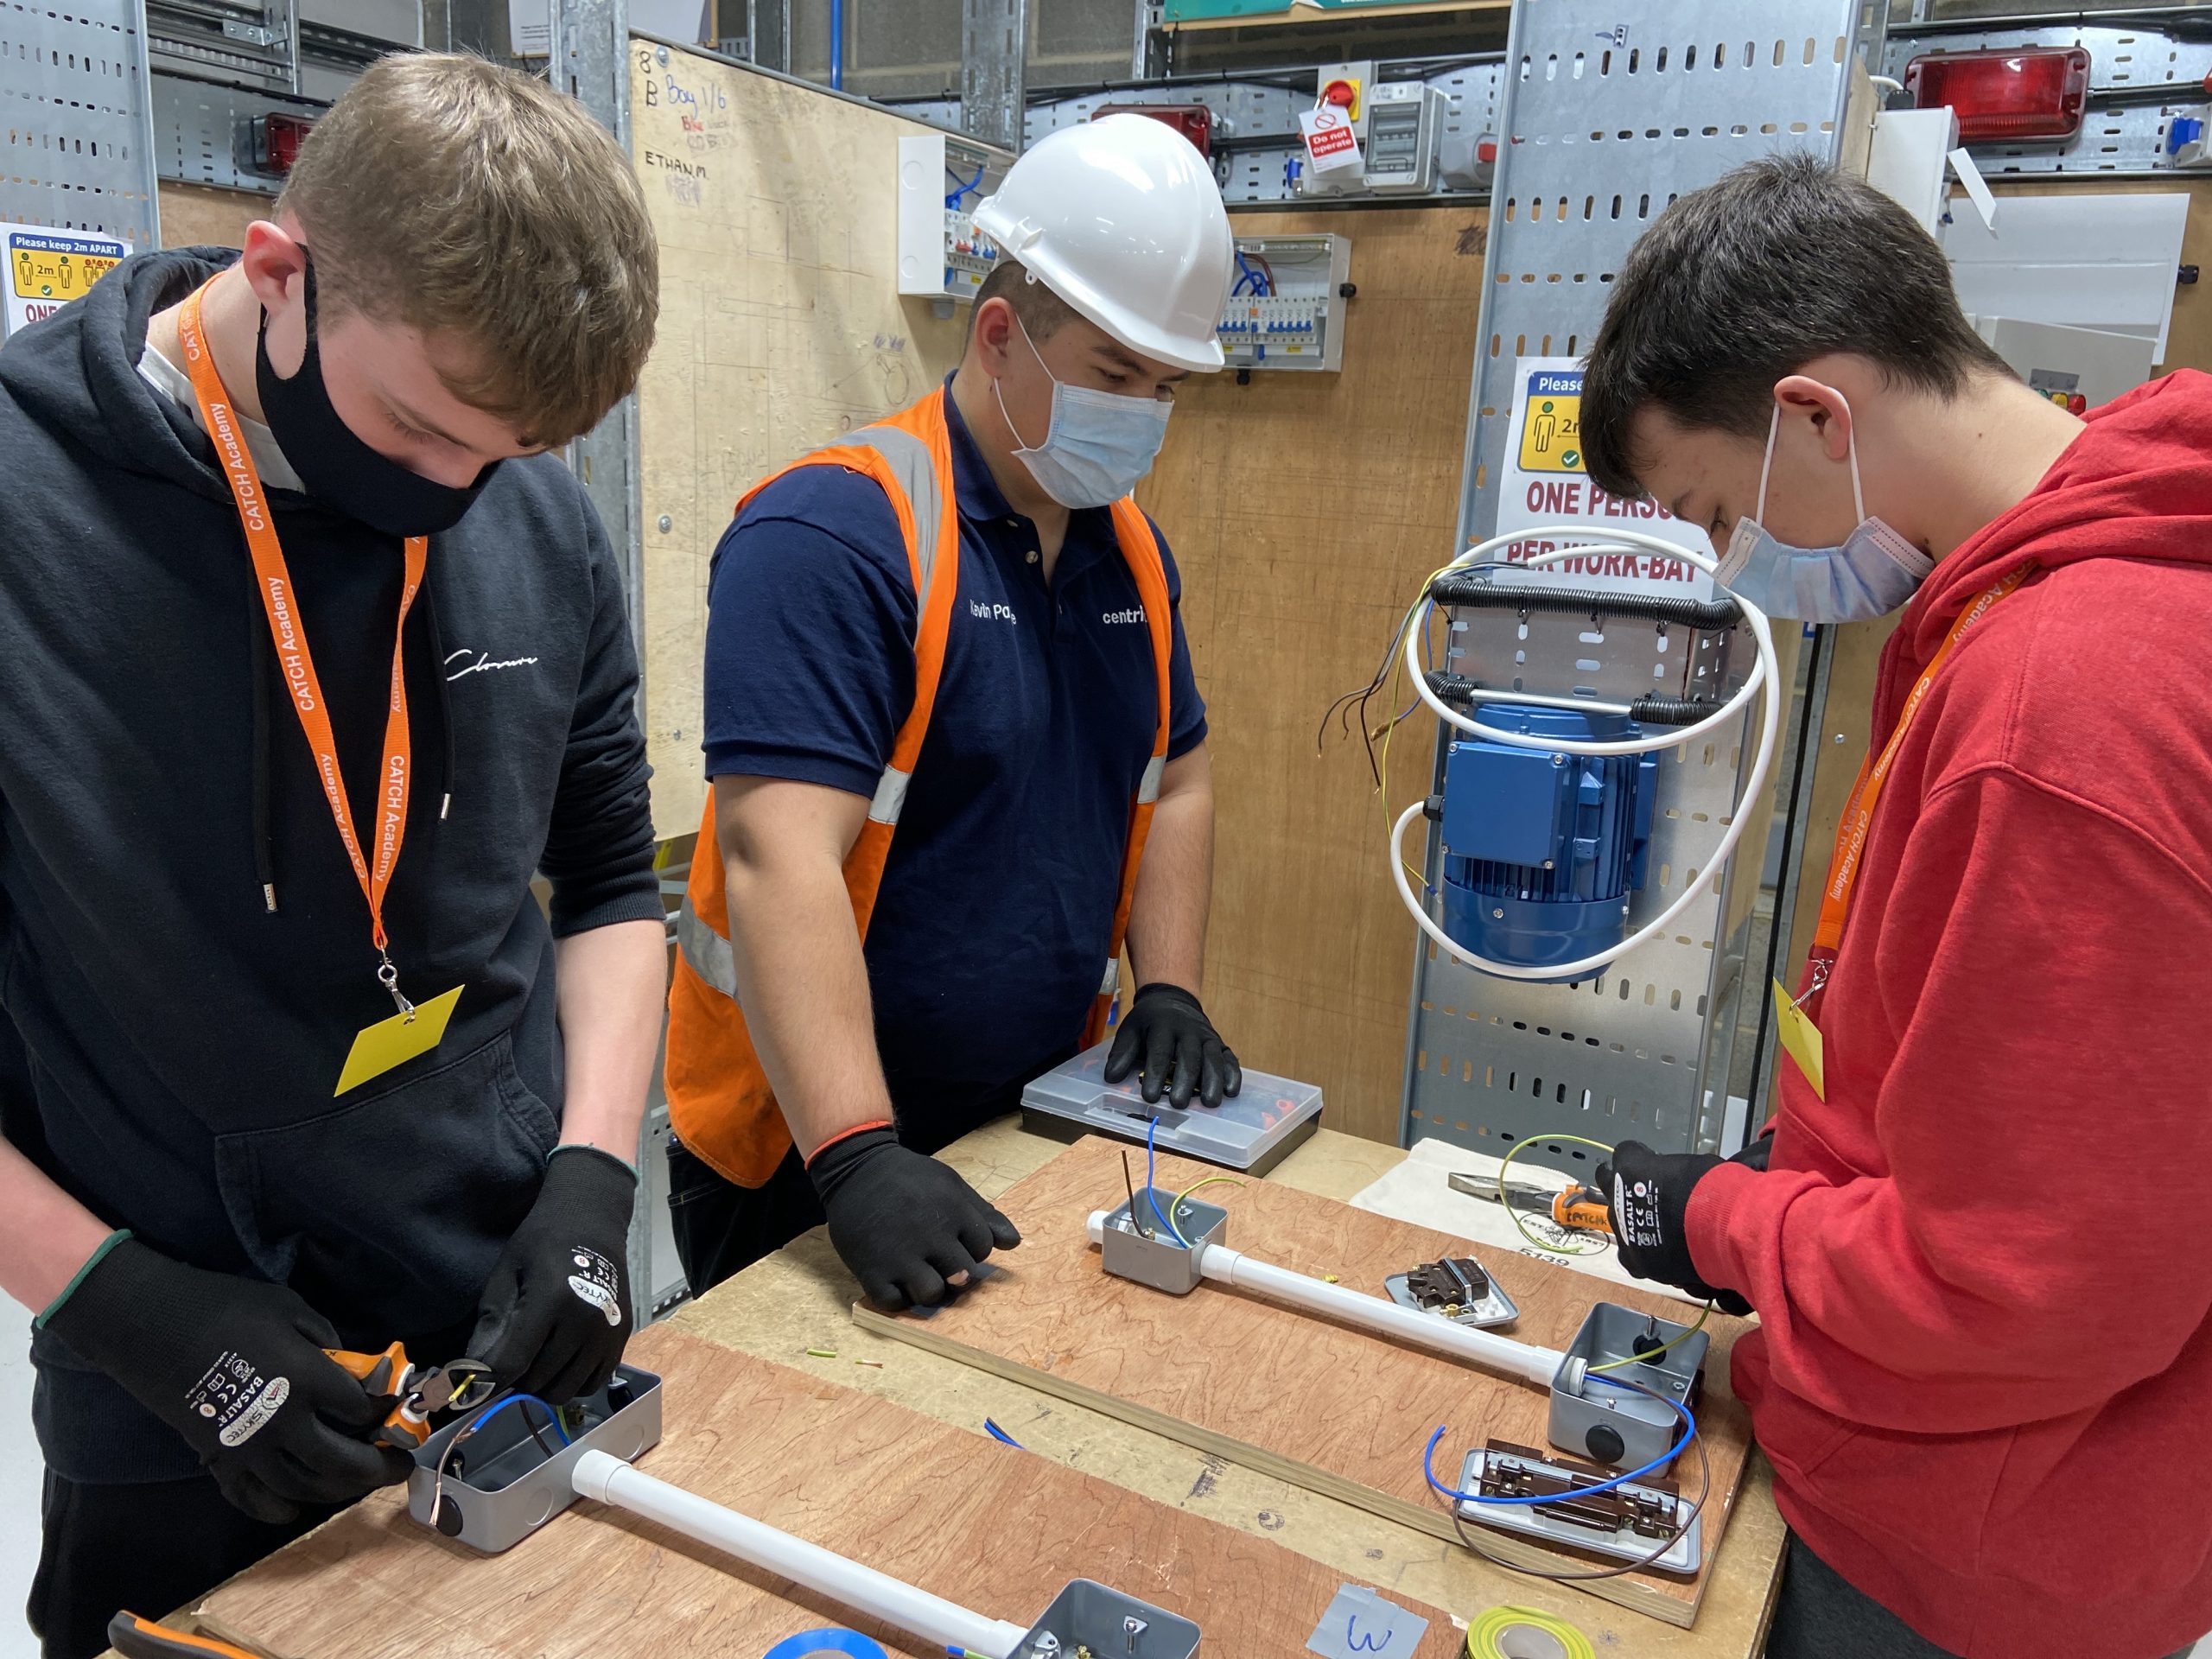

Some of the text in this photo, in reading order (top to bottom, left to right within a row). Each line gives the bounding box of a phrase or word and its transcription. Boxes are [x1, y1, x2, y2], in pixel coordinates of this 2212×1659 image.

[1313, 130, 1348, 145] Do not
[1313, 139, 1352, 155] operate
[16, 236, 118, 255] Please keep 2m APART
[37, 264, 54, 276] 2m
[210, 403, 264, 531] CATCH Academy
[1526, 481, 1581, 515] ONE
[1507, 540, 1555, 572] PER
[993, 604, 1017, 625] Pae
[1103, 604, 1147, 624] centri
[268, 577, 315, 711] CATCH Academy
[321, 753, 365, 879] CATCH Academy
[375, 755, 404, 882] CATCH Academy
[1850, 810, 1867, 853] CATCH
[1829, 850, 1855, 902] Academy
[1626, 1199, 1636, 1243] BASALT
[217, 1383, 238, 1404] CE
[225, 1376, 264, 1419] BASALT
[226, 1409, 263, 1444] SKYTEC
